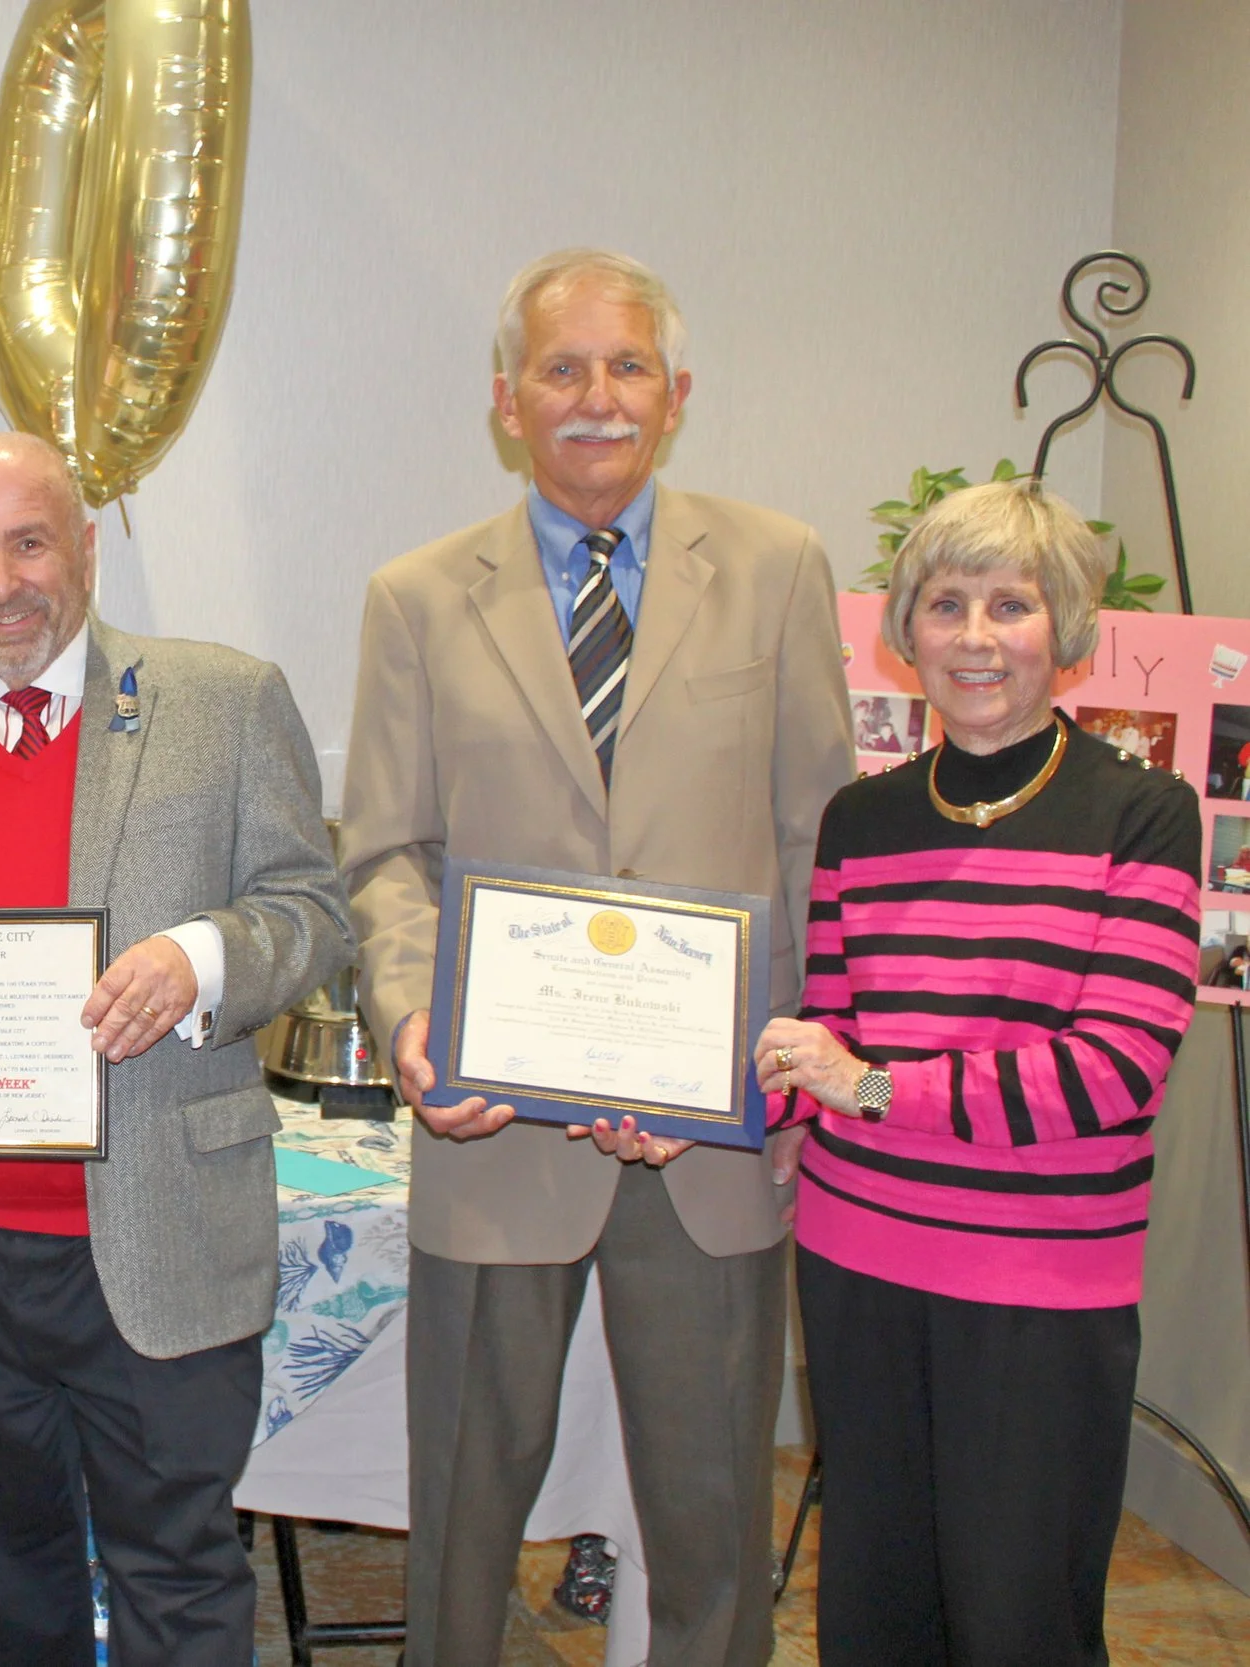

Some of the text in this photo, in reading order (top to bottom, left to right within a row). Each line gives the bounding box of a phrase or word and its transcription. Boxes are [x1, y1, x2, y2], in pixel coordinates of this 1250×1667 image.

[6, 930, 35, 942] CITY
[508, 911, 574, 939] The State of
[654, 924, 713, 967] New Jersey
[570, 987, 610, 1004] Irene
[614, 993, 681, 1013] Bukowski
